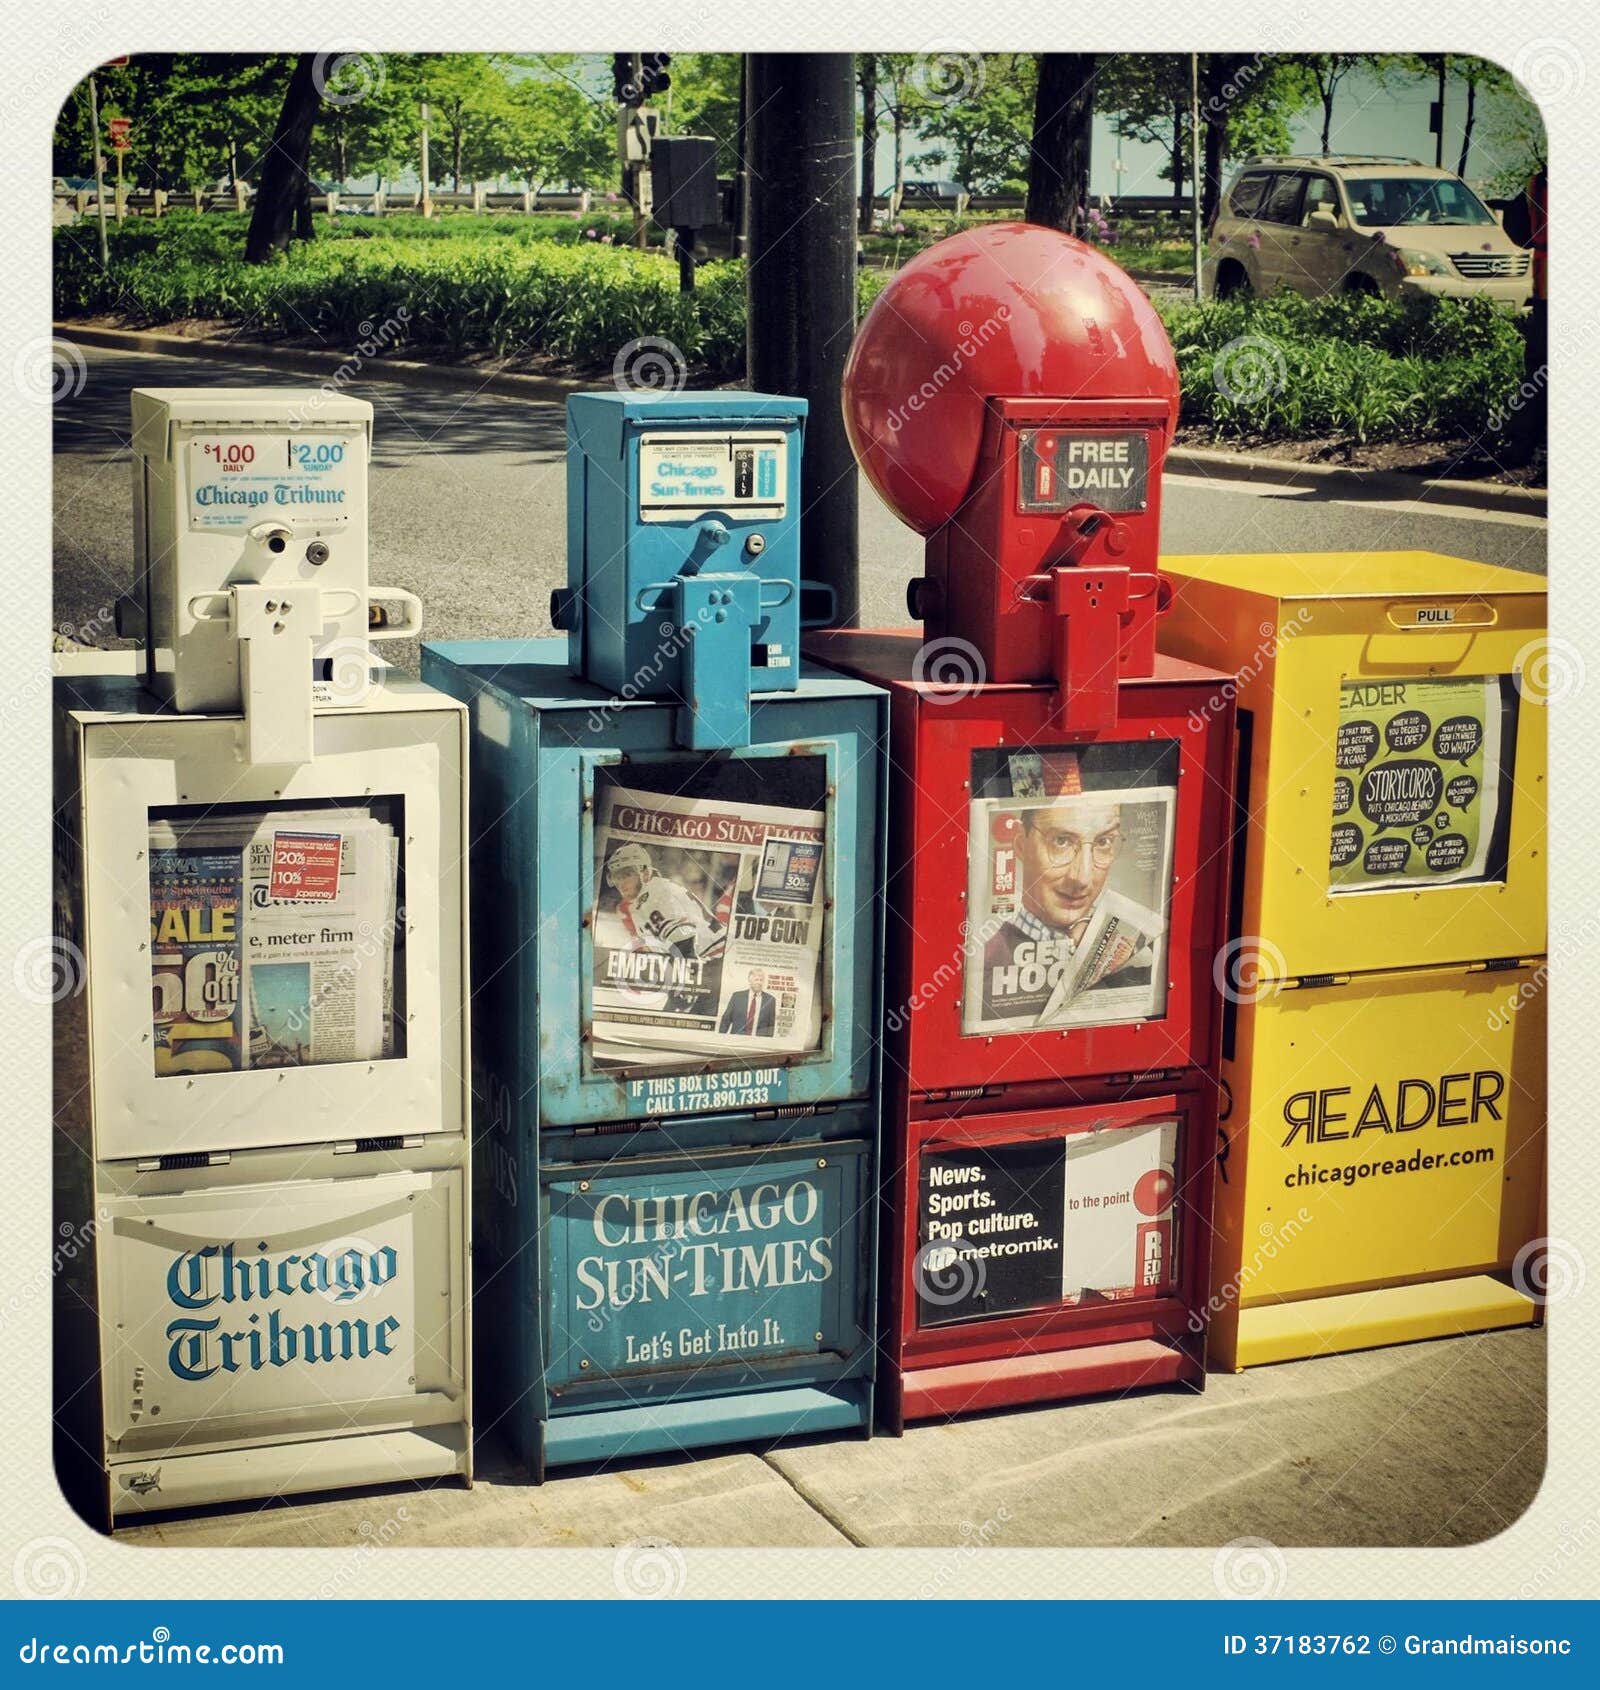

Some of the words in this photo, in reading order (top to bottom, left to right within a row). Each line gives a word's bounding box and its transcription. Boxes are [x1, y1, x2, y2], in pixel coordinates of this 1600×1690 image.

[204, 444, 254, 463] $1.00
[292, 444, 343, 463] $2.00
[1069, 442, 1129, 463] FREE
[223, 464, 244, 472] DAILY
[657, 462, 717, 479] Chicago
[740, 461, 748, 495] DAILY
[1068, 468, 1134, 489] DAILY
[196, 484, 268, 507] Chicago
[274, 484, 345, 505] Tribune
[651, 482, 725, 497] Sun-Times
[1418, 610, 1452, 622] PULL
[768, 644, 782, 655] COIN
[768, 656, 791, 668] RETURN
[1351, 734, 1374, 745] BECOME
[1360, 726, 1373, 735] TIME
[1388, 728, 1400, 736] YOU
[1401, 726, 1419, 735] DECIDE
[1421, 724, 1428, 733] TO
[1394, 734, 1424, 746] ELOPE?
[1438, 742, 1449, 754] SO
[1451, 740, 1477, 754] WHAT?
[1349, 754, 1367, 765] GANG
[1366, 767, 1438, 802] STORYCORPS
[1367, 801, 1382, 814] PUTS
[1384, 800, 1410, 812] CHICAGO
[1411, 799, 1433, 811] BEHIND
[617, 807, 712, 840] CHICAGO
[1385, 811, 1420, 823] MICROPHONE
[278, 851, 306, 865] 20%
[1444, 856, 1462, 865] LUCKY
[278, 871, 302, 884] 10%
[995, 872, 1013, 883] ed
[995, 882, 1013, 892] eye
[295, 889, 335, 899] jcpenney
[150, 906, 237, 943] ALE
[734, 915, 769, 940] TOP
[770, 918, 810, 946] GUN
[268, 932, 316, 946] meter
[320, 928, 353, 943] firm
[1013, 938, 1075, 968] GET
[606, 950, 671, 984] EMPTY
[671, 957, 707, 986] NET
[203, 975, 240, 1003] off
[632, 1080, 644, 1097] IF
[647, 1079, 675, 1096] THIS
[679, 1076, 703, 1093] BOX
[706, 1073, 719, 1090] IS
[721, 1070, 750, 1089] SOLD
[755, 1067, 782, 1087] OUT,
[646, 1096, 676, 1114] CALL
[678, 1087, 769, 1112] 1.773.890.7333
[1281, 1070, 1505, 1148] READER
[929, 1165, 987, 1187] News.
[1284, 1147, 1495, 1189] chicagoreader.com
[928, 1188, 997, 1217] Sports.
[1069, 1197, 1080, 1211] to
[1083, 1195, 1101, 1209] the
[1102, 1191, 1131, 1210] point
[592, 1180, 819, 1248] CHICAGO
[928, 1219, 963, 1243] Pop
[967, 1210, 1039, 1236] culture.
[958, 1236, 1060, 1262] metromix.
[1144, 1230, 1163, 1260] R
[166, 1240, 398, 1310] Chicago
[575, 1236, 834, 1311] SUN-TIMES
[1143, 1259, 1162, 1276] ED
[1143, 1275, 1161, 1287] EYE
[166, 1308, 401, 1382] Tribune
[625, 1332, 673, 1364] Let's
[678, 1327, 712, 1357] Get
[717, 1323, 759, 1352] Into
[763, 1318, 785, 1346] It.
